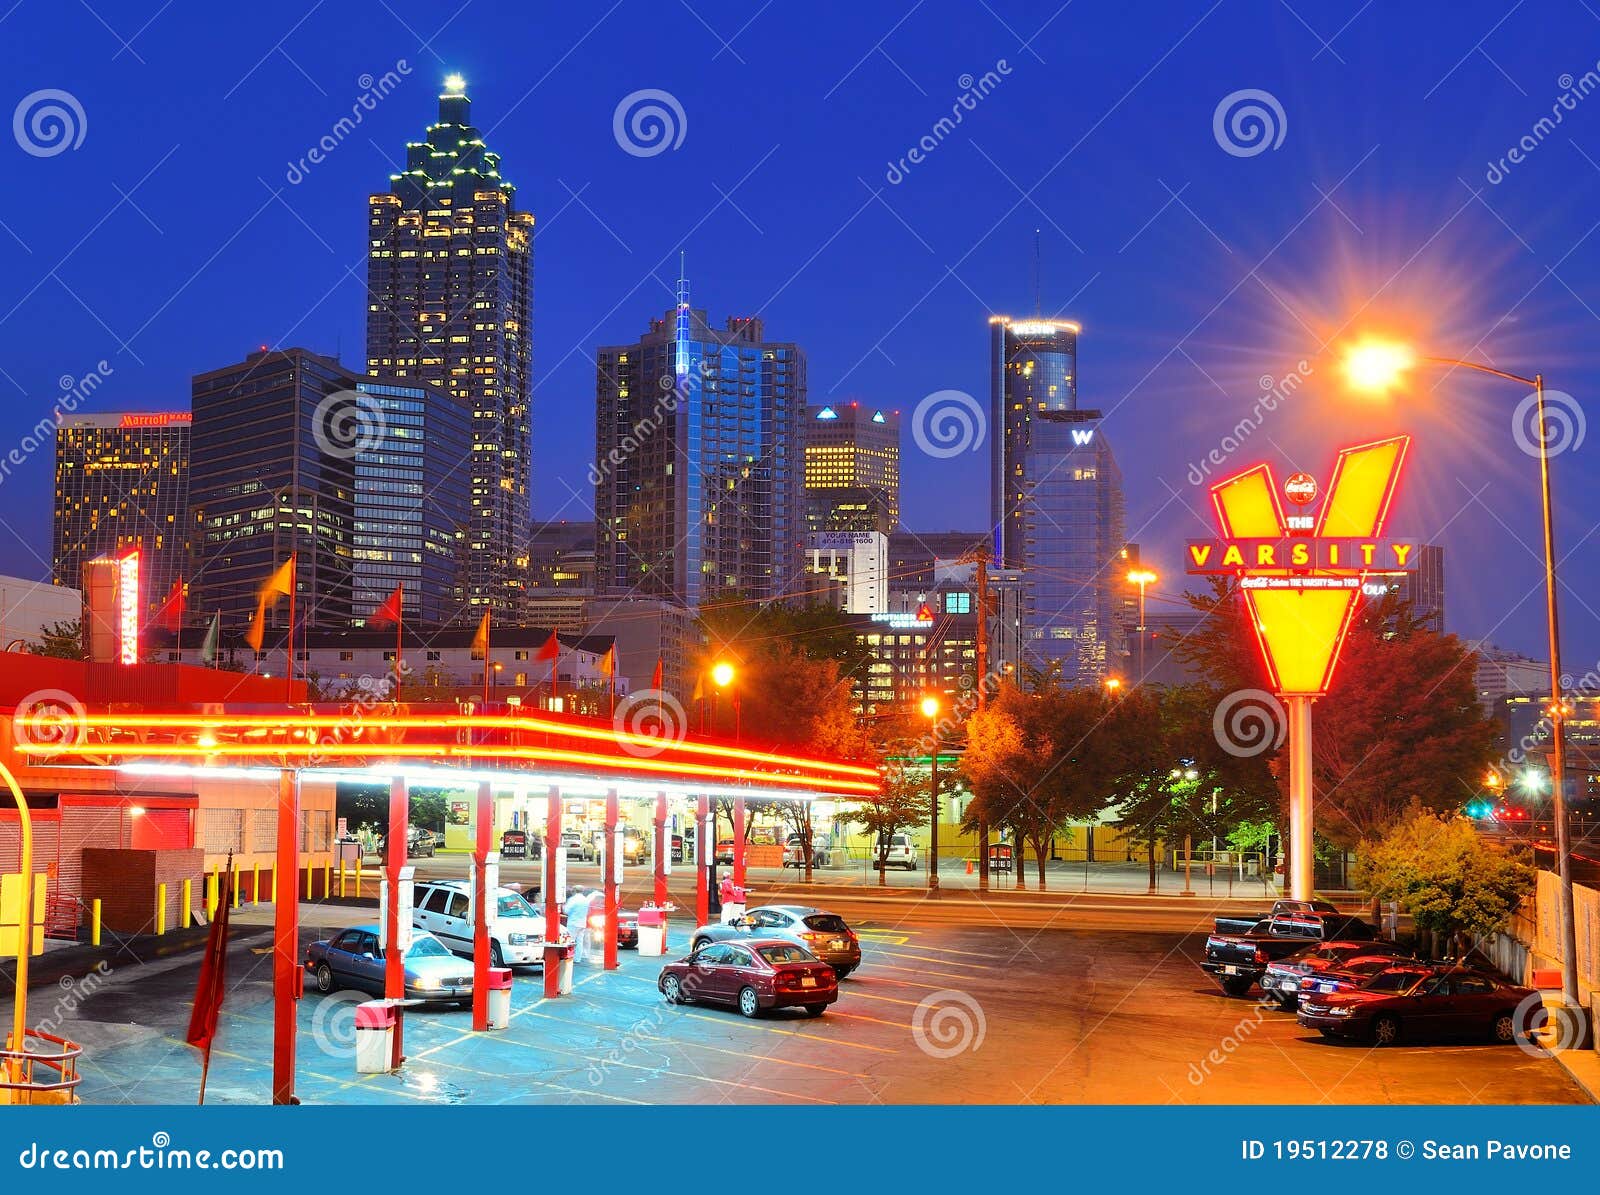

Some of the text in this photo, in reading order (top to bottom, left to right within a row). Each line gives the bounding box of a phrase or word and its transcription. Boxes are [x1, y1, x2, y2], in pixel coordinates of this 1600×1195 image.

[120, 415, 168, 427] Marriott
[1071, 429, 1094, 445] W
[1286, 516, 1314, 529] THE
[1190, 544, 1412, 566] VARSITY
